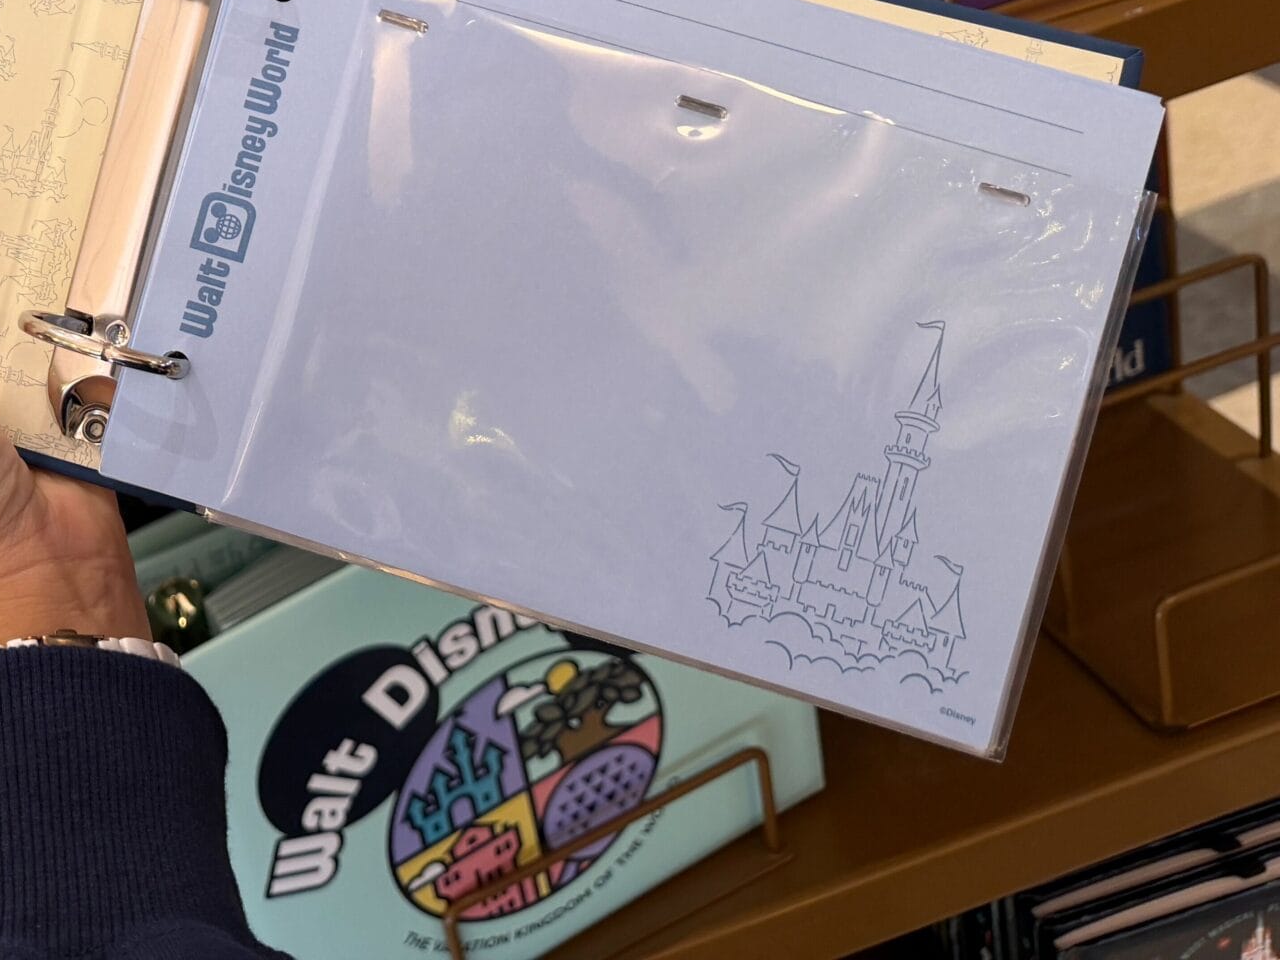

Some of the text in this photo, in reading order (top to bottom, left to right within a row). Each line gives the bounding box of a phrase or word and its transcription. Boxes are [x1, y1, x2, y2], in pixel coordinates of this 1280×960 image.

[179, 20, 300, 339] Walt Disney World
[266, 738, 379, 899] Walt
